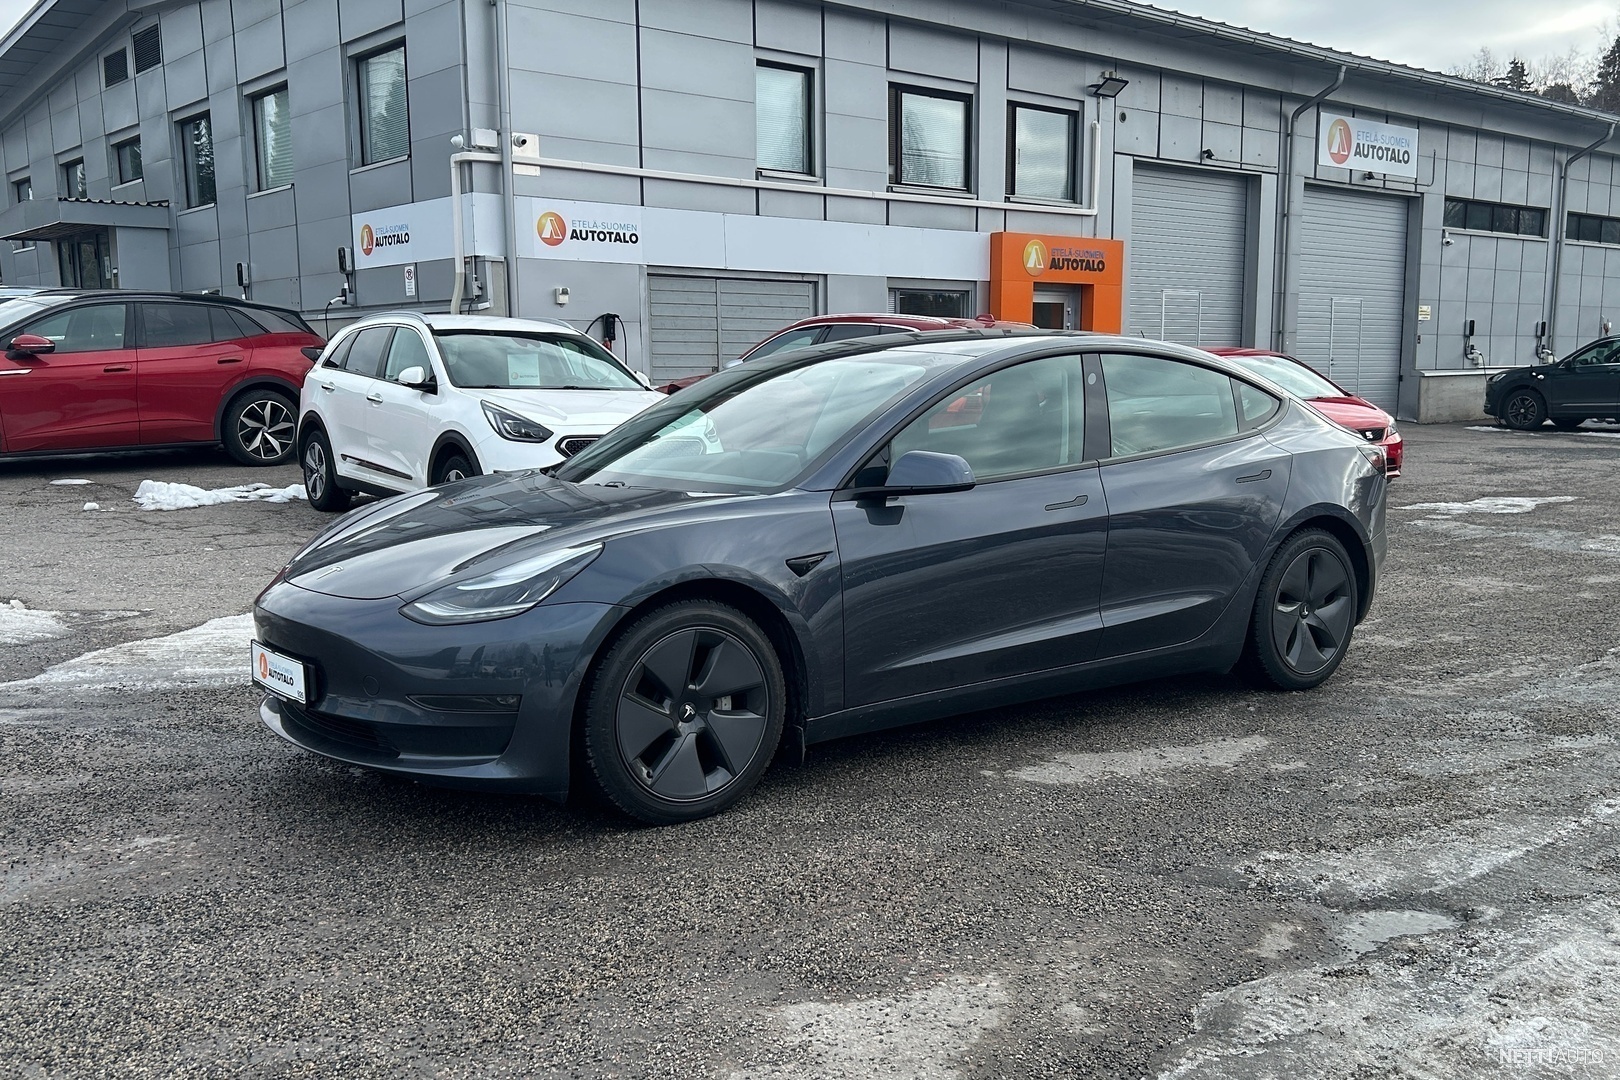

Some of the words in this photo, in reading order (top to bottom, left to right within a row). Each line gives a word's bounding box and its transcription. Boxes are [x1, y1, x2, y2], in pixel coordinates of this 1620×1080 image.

[1356, 130, 1410, 149] ETELÄ-SUOMEN
[1354, 142, 1410, 164] AUTOTALO
[375, 223, 409, 236] ETELÄ-SUOMEN
[571, 219, 638, 232] ETELÄ-SUOMEN
[375, 232, 410, 248] AUTOTALO
[569, 229, 639, 244] AUTOTALO
[1051, 247, 1105, 260] ETELÄ-SUOMEN
[1049, 257, 1106, 272] AUTOTALO
[268, 667, 295, 686] AUTOTALO
